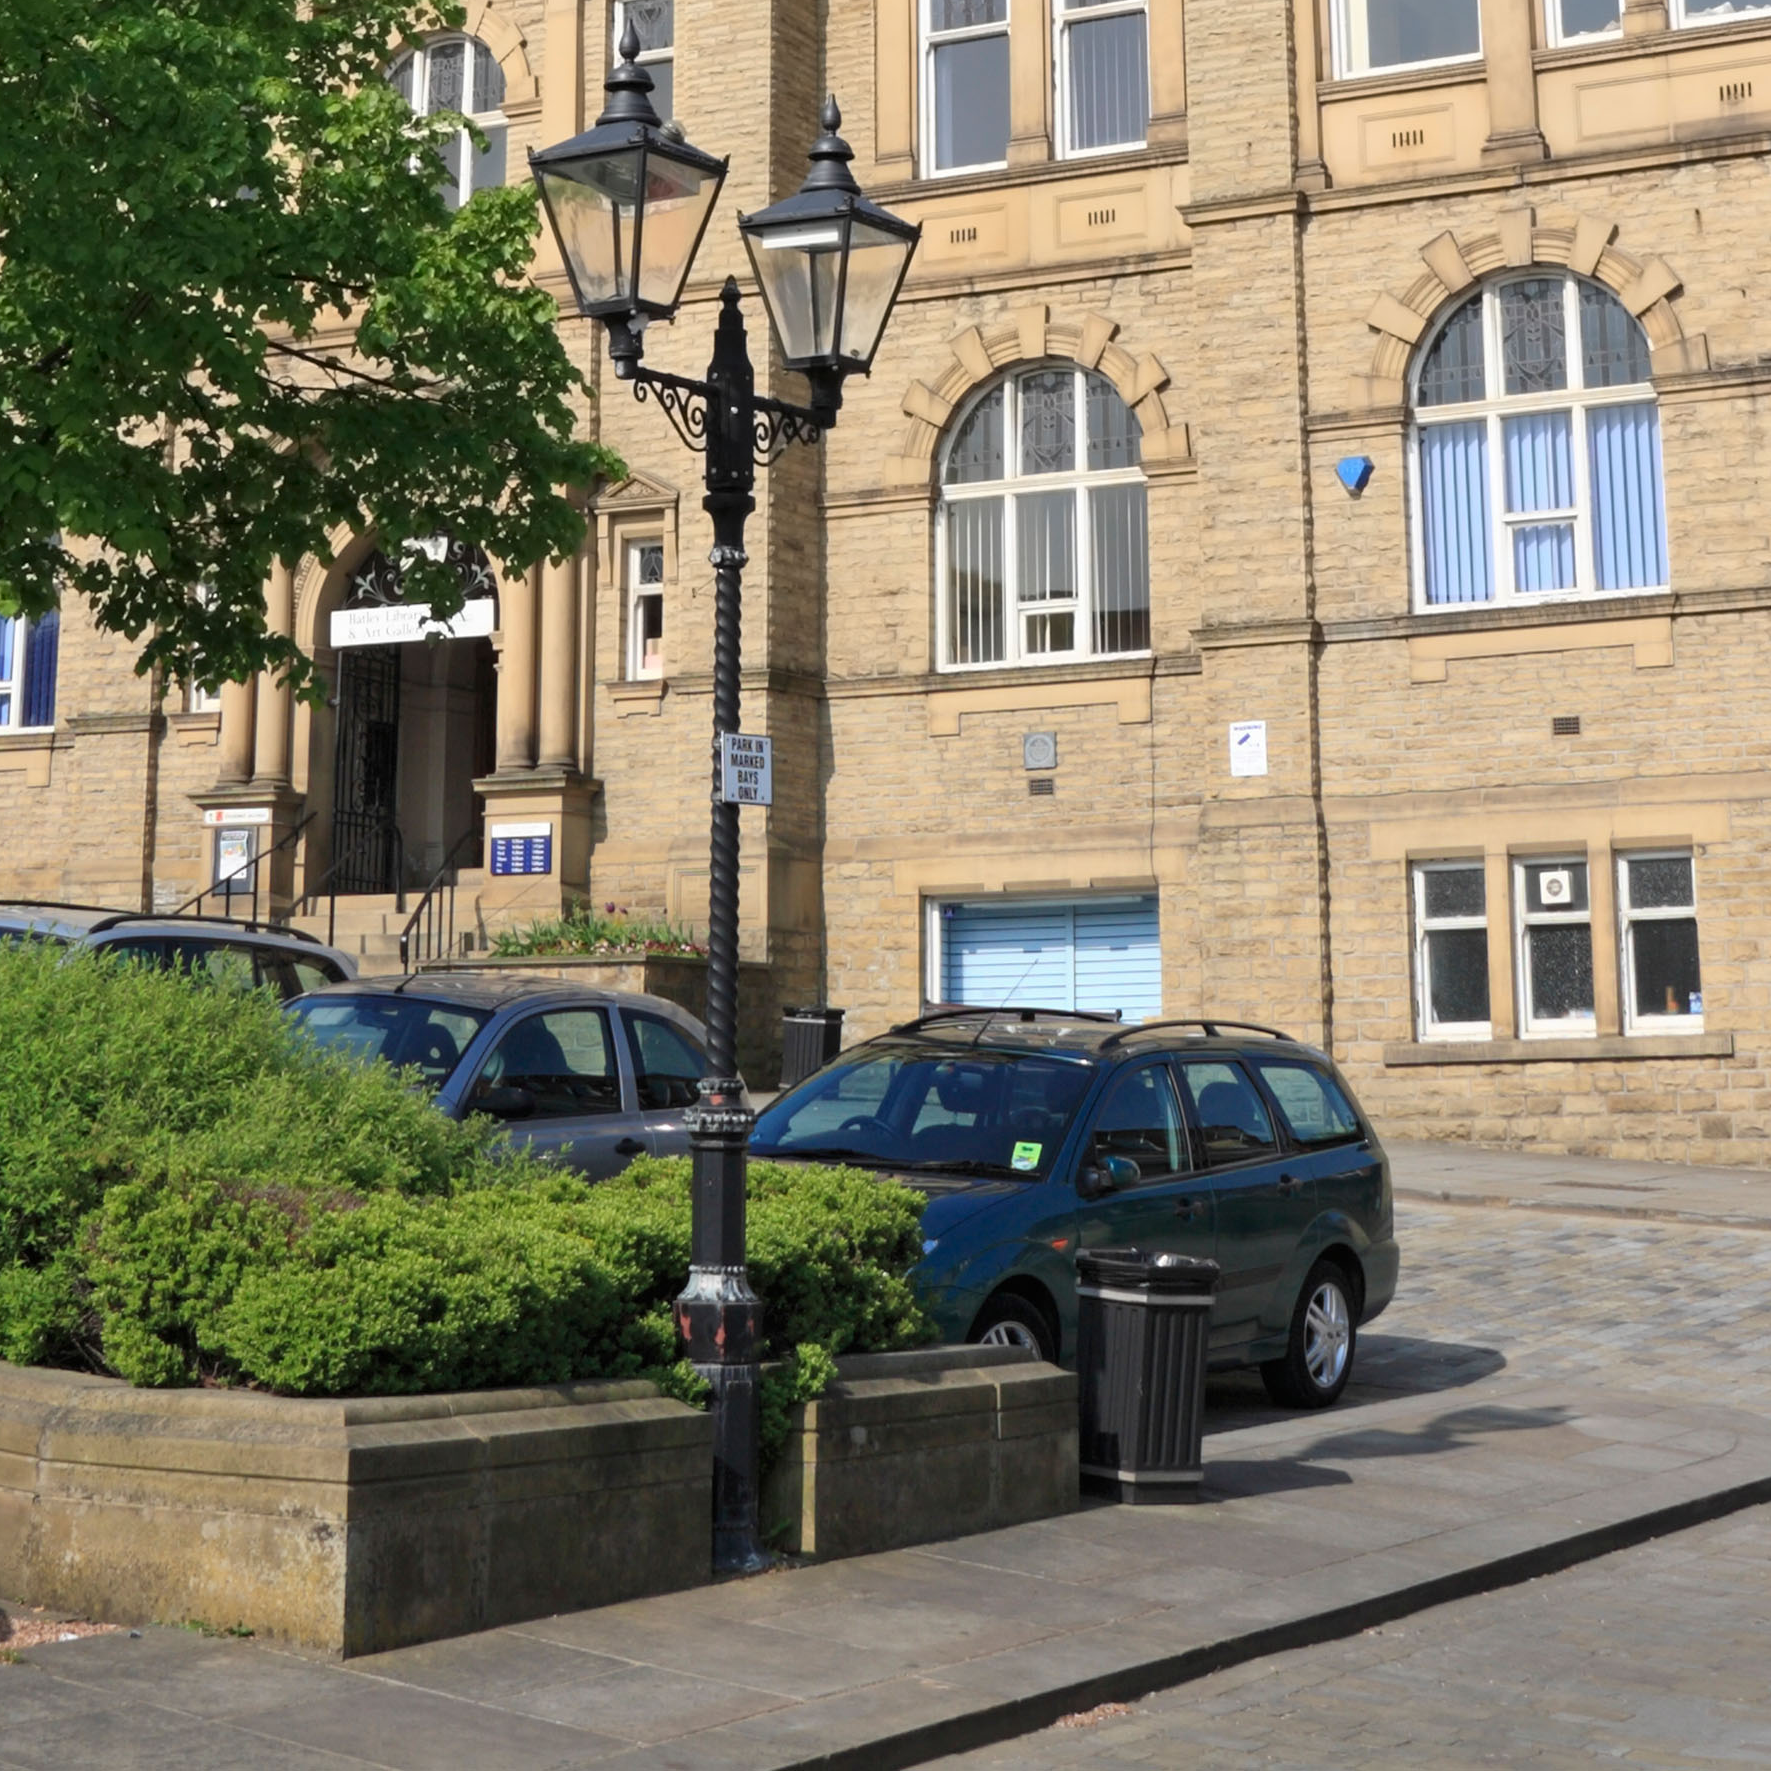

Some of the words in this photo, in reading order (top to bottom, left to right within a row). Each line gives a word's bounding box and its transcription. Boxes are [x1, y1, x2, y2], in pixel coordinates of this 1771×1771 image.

[731, 737, 753, 752] PARK
[755, 740, 764, 753] IN
[730, 753, 765, 770] MARKED
[737, 769, 759, 785] BAYS
[737, 786, 759, 800] ONLY
